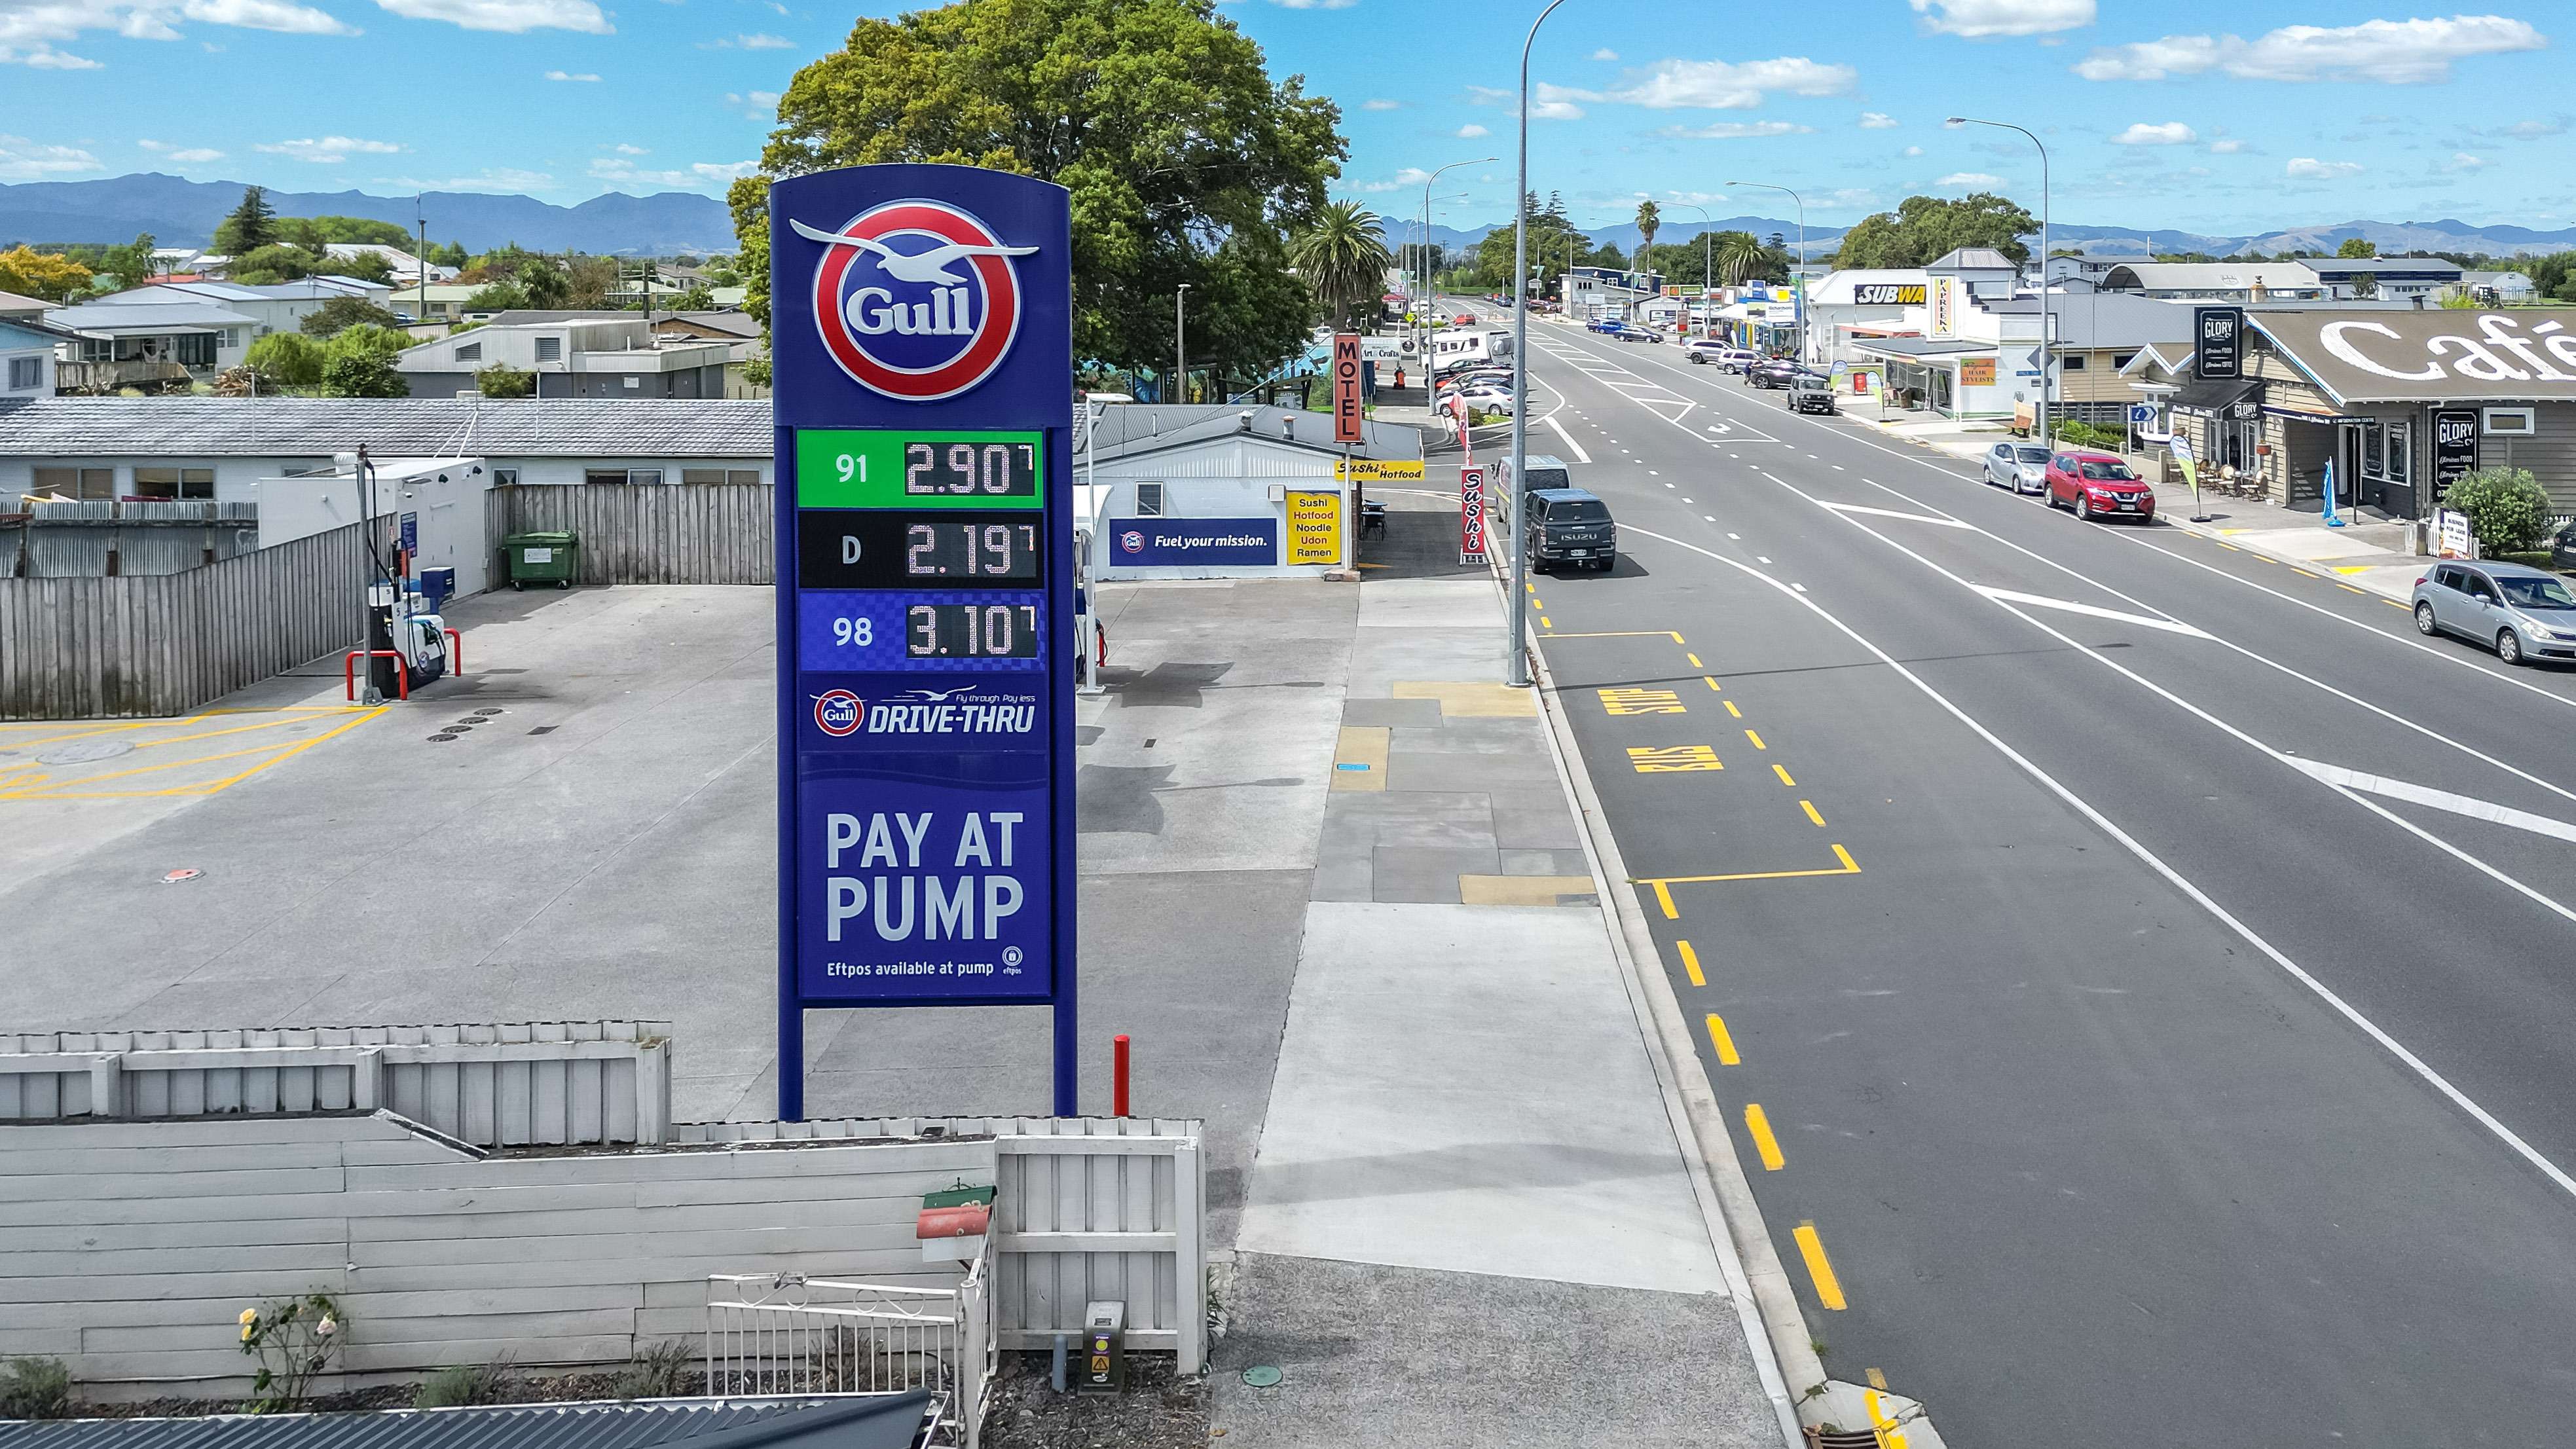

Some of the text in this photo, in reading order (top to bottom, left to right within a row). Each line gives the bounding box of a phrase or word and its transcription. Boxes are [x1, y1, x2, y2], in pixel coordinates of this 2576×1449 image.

[1857, 285, 1926, 304] SUBWA
[846, 287, 974, 335] Gull
[2205, 321, 2233, 338] GLORY
[1338, 342, 1357, 435] MOTEL
[2235, 403, 2257, 418] GLORY
[2439, 424, 2474, 443] GLORY
[836, 454, 867, 483] 91
[1337, 463, 1379, 473] Sushi
[1380, 470, 1422, 479] Hotfood
[1294, 511, 1333, 519] Hotfood
[1463, 472, 1482, 550] Sushi
[843, 536, 862, 564] D
[1155, 534, 1268, 549] Fuel your mission.
[833, 617, 873, 646] 98
[956, 694, 968, 704] Fly
[969, 694, 1000, 704] through
[1002, 694, 1018, 704] Pay
[824, 709, 853, 722] Gull
[868, 705, 1035, 733] DRIVE-THRU
[827, 812, 1023, 868] PAY AT
[827, 875, 1023, 942] PUMP
[827, 961, 994, 978] Eftpos available at pump
[1003, 967, 1022, 976] eftpos
